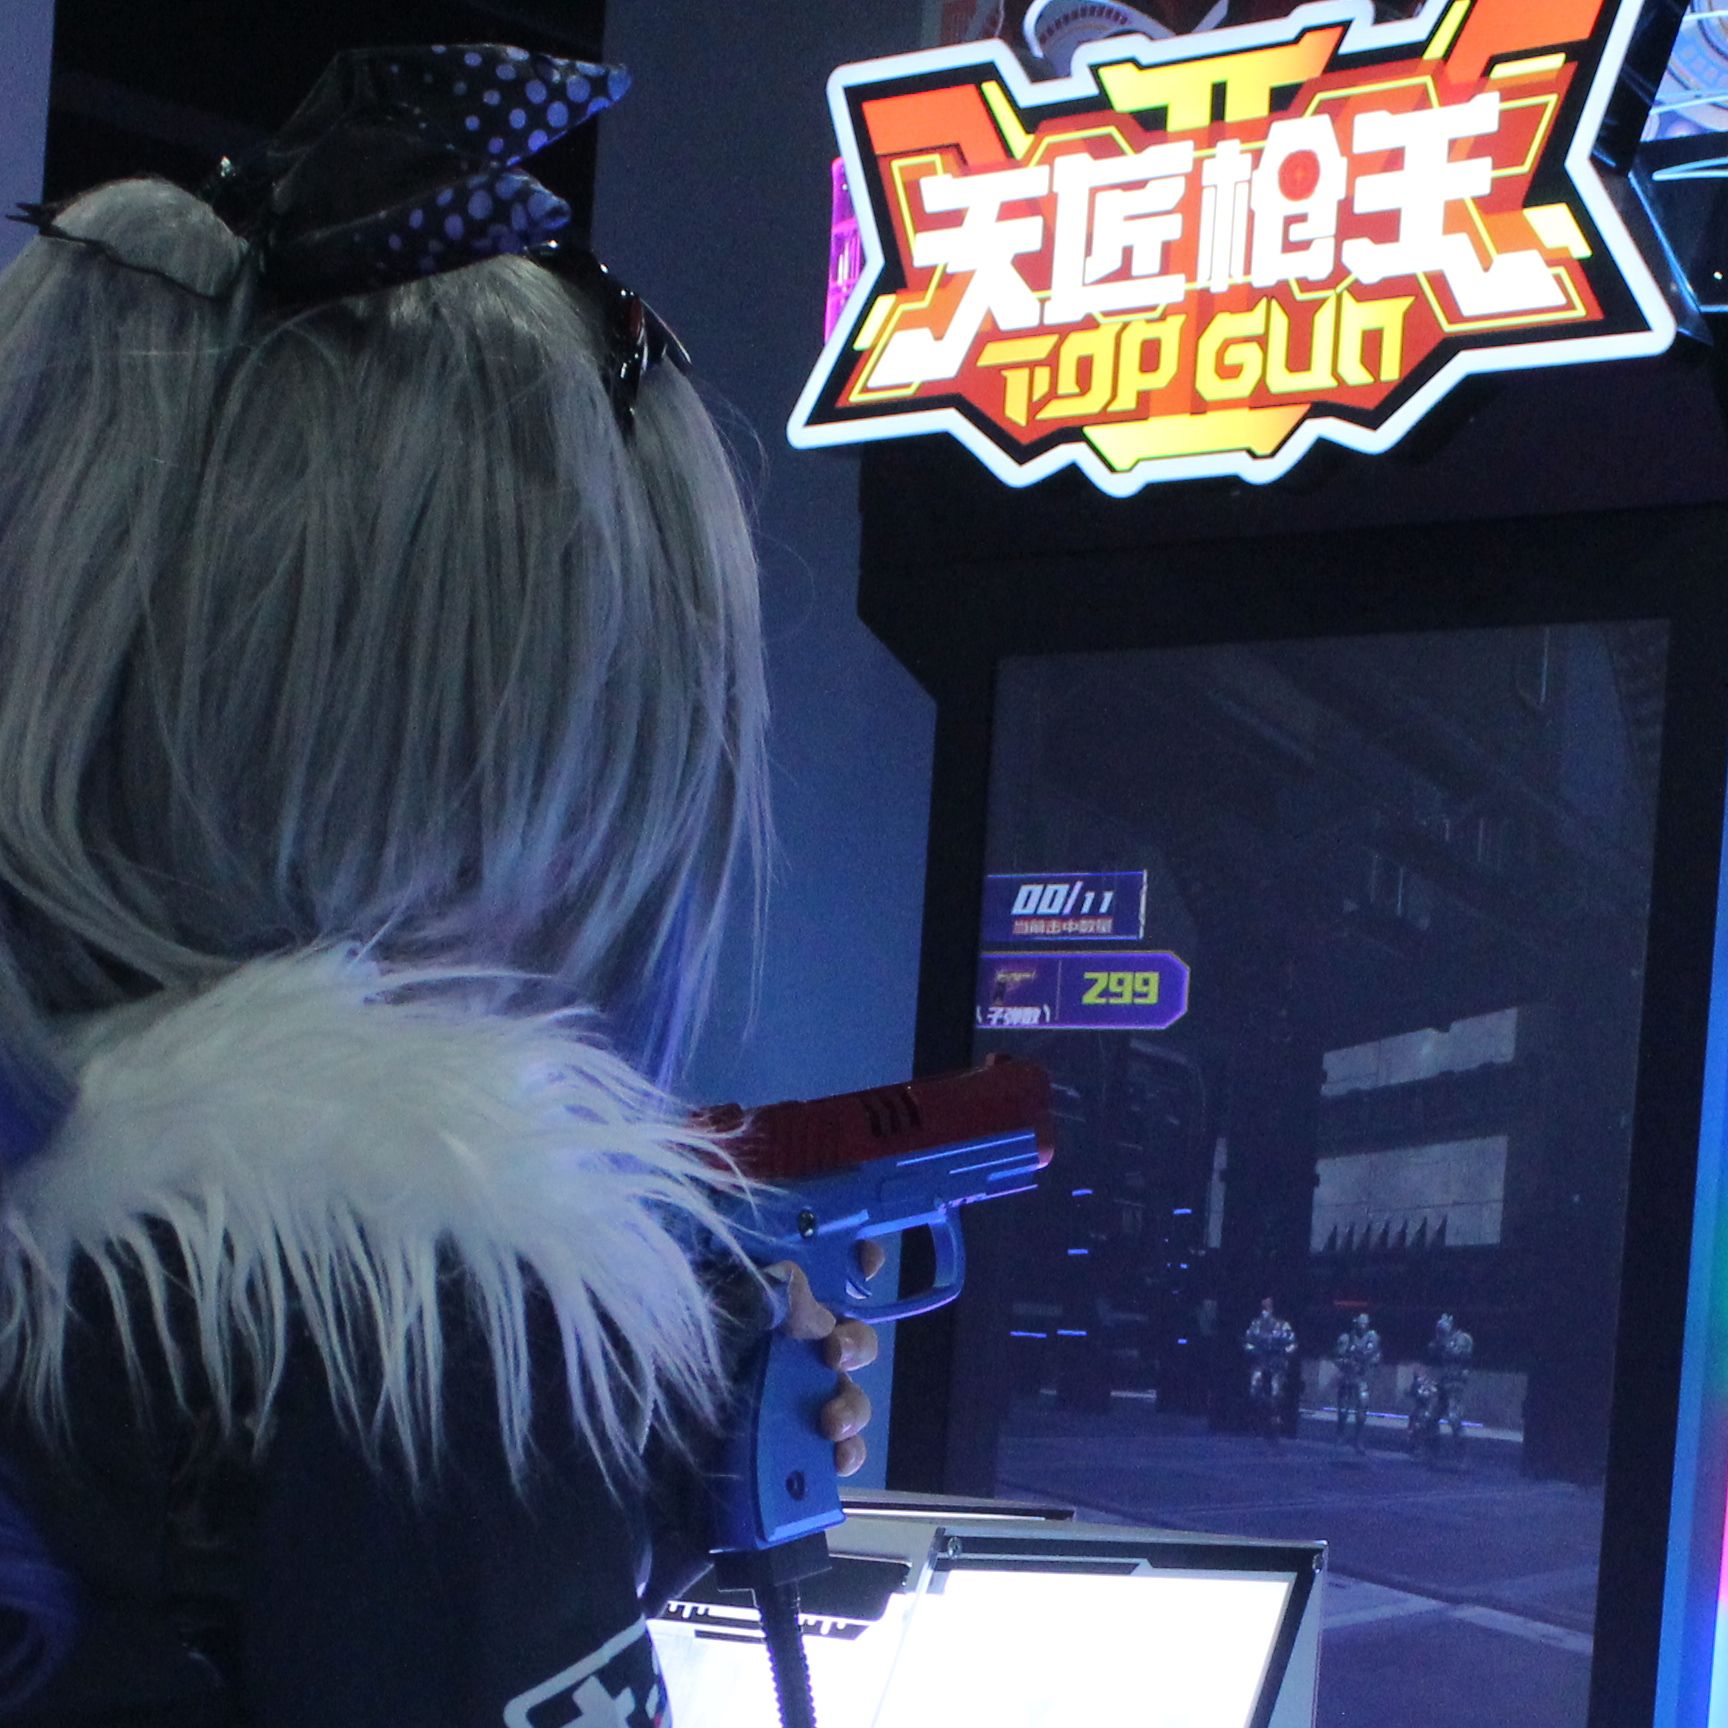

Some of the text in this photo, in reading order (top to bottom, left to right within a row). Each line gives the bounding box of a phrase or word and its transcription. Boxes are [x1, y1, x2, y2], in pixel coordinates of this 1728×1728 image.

[867, 91, 1566, 390] 天匠枪王
[976, 287, 1416, 428] TOP GUN
[1011, 881, 1114, 915] 00/11
[1081, 971, 1160, 1004] 299
